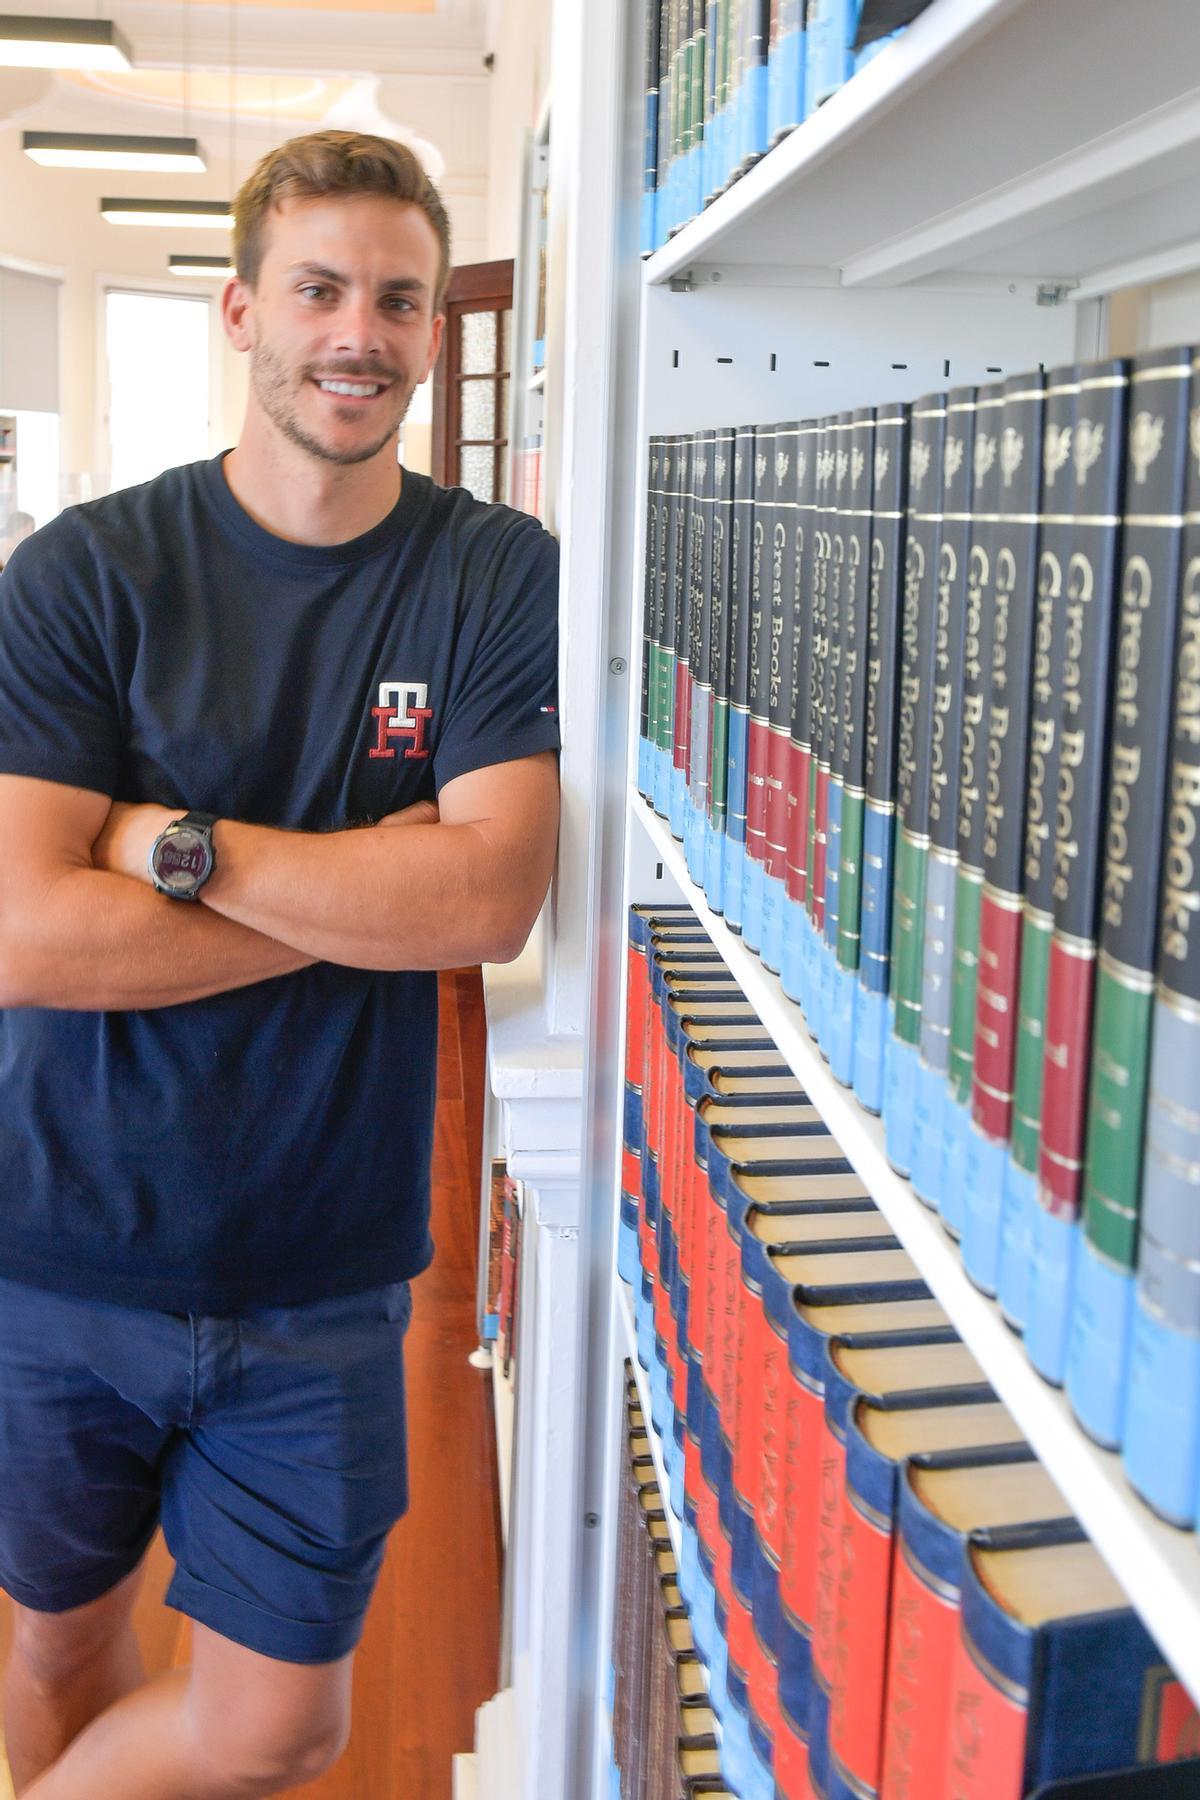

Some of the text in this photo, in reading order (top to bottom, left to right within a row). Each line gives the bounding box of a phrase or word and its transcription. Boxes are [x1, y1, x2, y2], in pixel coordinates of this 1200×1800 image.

[750, 521, 763, 698] Great Books
[770, 522, 785, 708] Great Books
[791, 526, 803, 720] Great Books
[828, 534, 844, 752] Great Books
[842, 534, 860, 762] Great Books
[866, 538, 885, 775] Great Books
[929, 542, 957, 821] Great Books
[958, 544, 989, 838] Great Books
[984, 547, 1016, 858] Great Books
[1025, 550, 1062, 880] Great Books
[1053, 552, 1093, 900] Great Books
[1106, 555, 1152, 927] Great Books
[1163, 556, 1200, 961] Great Books
